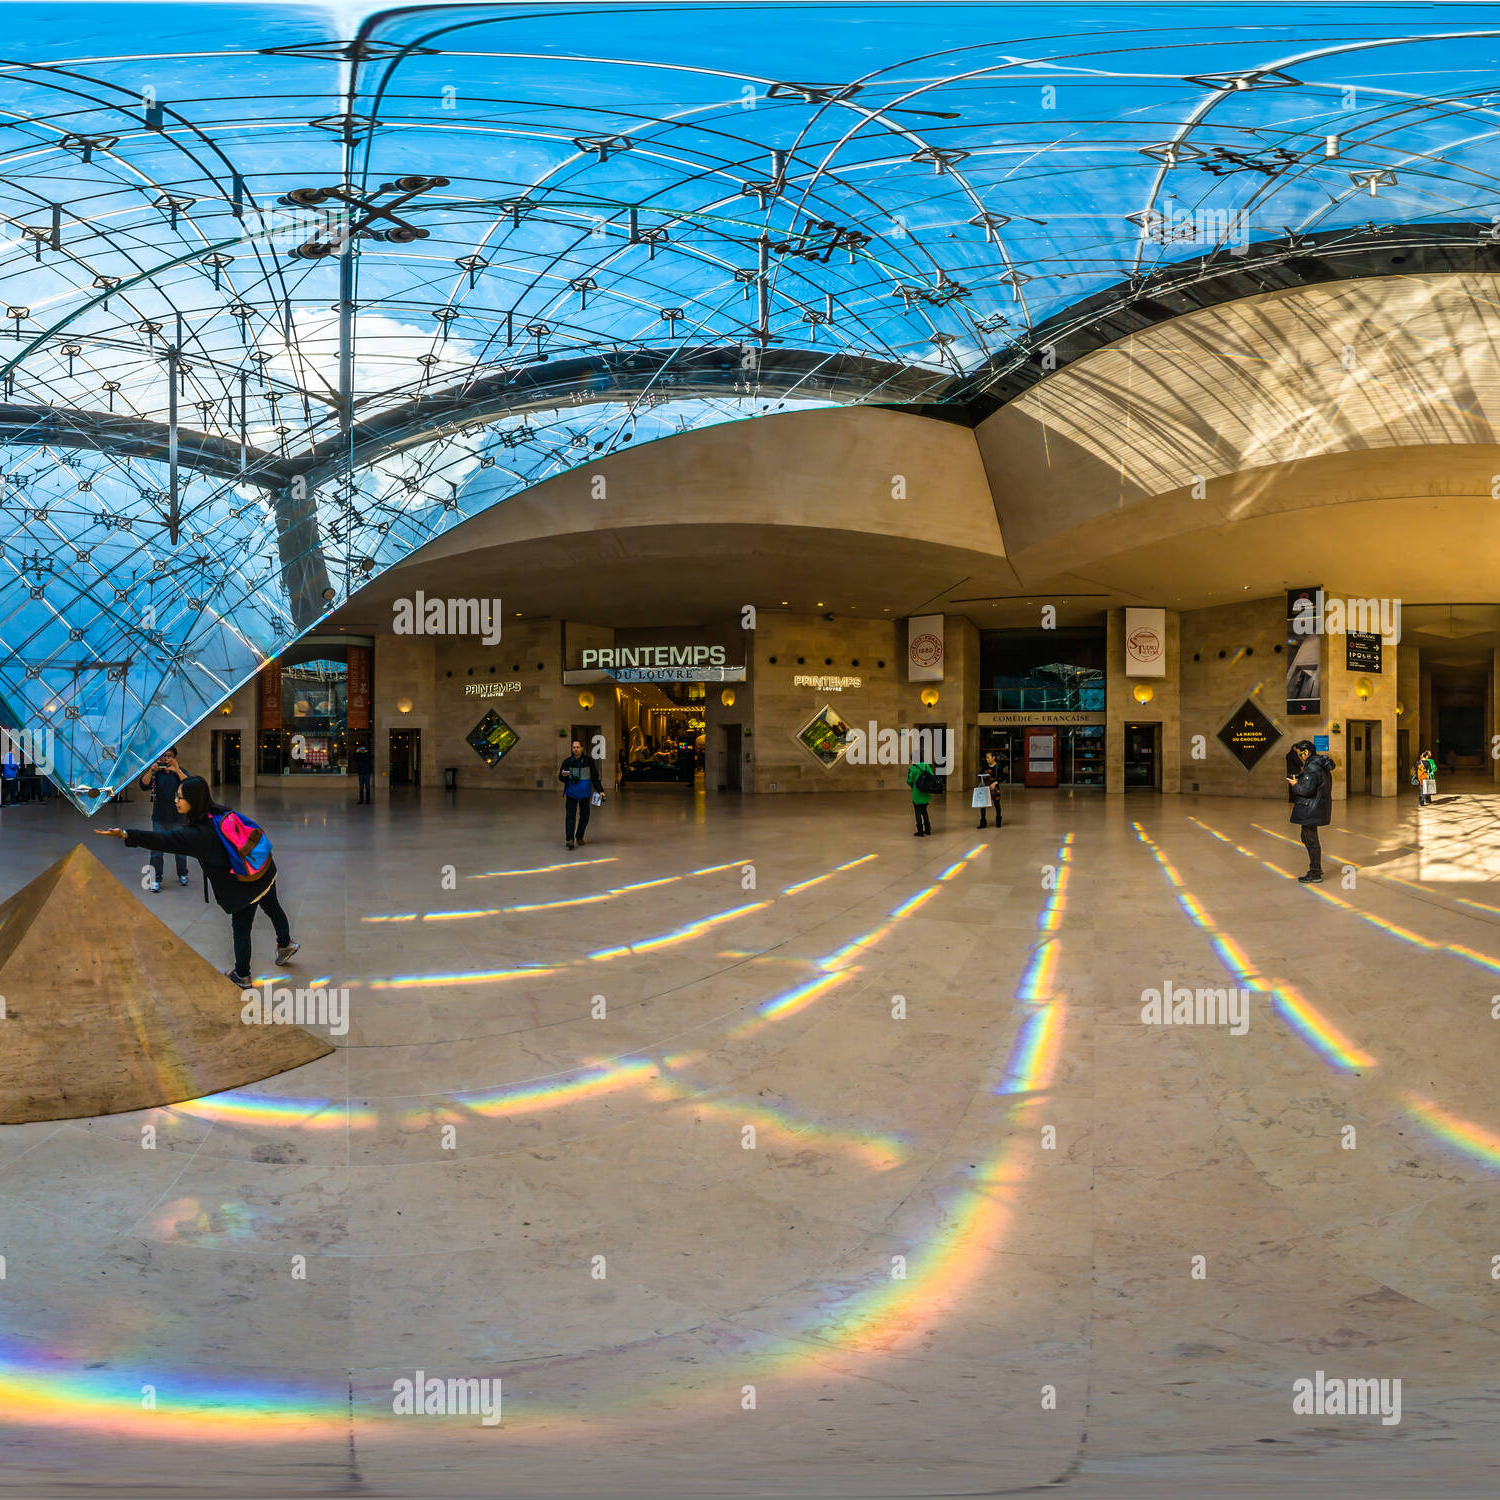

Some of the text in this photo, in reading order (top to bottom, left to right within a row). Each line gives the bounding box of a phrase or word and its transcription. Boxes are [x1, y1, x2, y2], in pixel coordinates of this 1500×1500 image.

[581, 645, 726, 669] PRINTEMPS
[614, 669, 693, 680] DU LOUVRE
[464, 681, 522, 695] PRINTEMPS
[794, 675, 862, 688] PRINTEMPS
